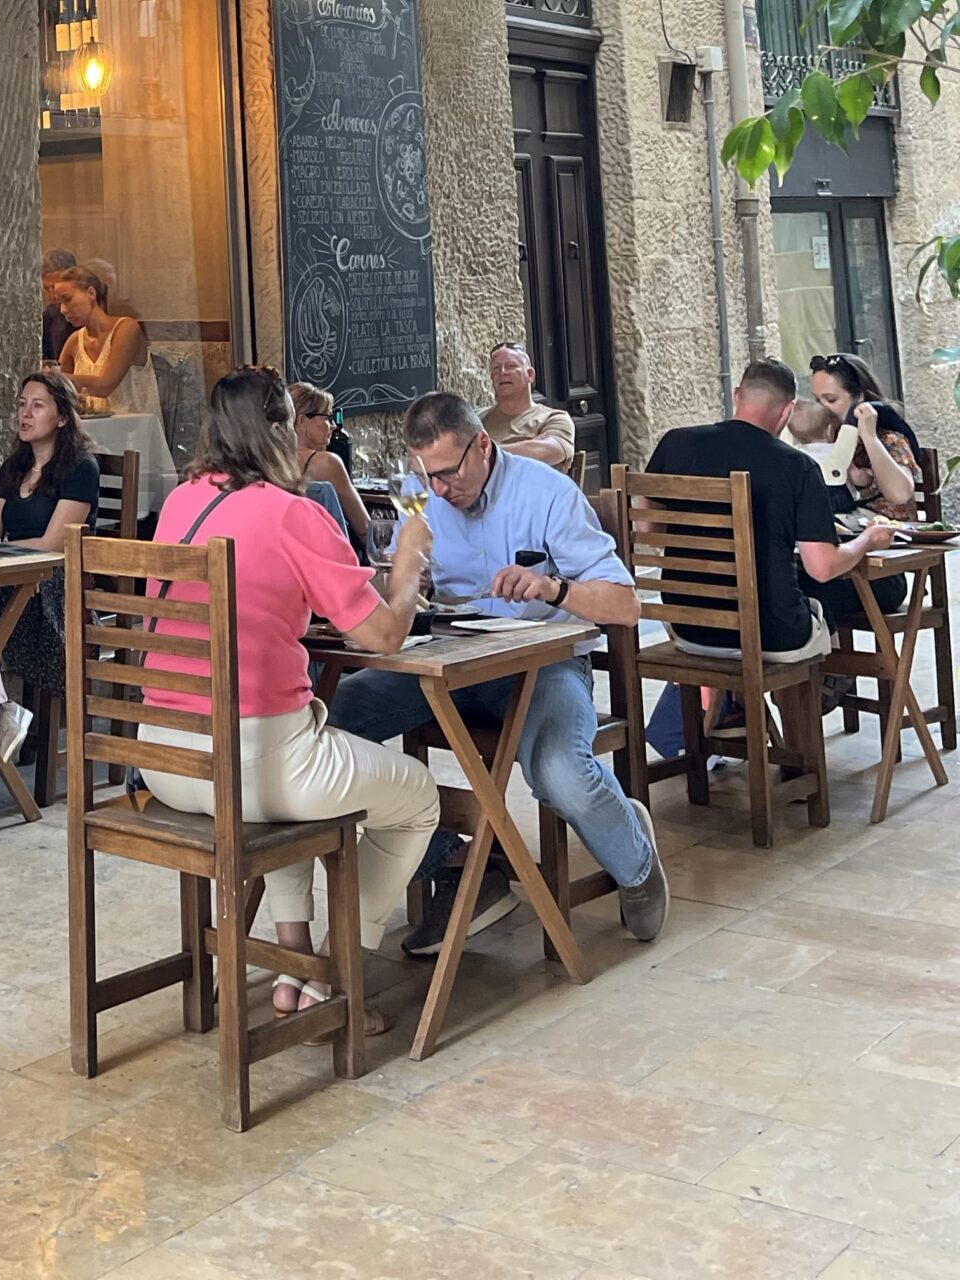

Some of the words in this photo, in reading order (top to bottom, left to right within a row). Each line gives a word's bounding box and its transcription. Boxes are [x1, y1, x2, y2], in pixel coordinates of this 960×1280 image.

[321, 99, 377, 135] Arroces
[292, 149, 325, 164] MARISCO
[328, 196, 333, 210] Y
[297, 210, 330, 225] SECRETO
[330, 235, 386, 271] Carnes
[351, 322, 377, 338] PLATO
[381, 321, 391, 336] LA
[394, 320, 418, 335] TASCA
[392, 356, 398, 371] A
[398, 355, 409, 370] LA
[410, 351, 432, 369] BRASA
